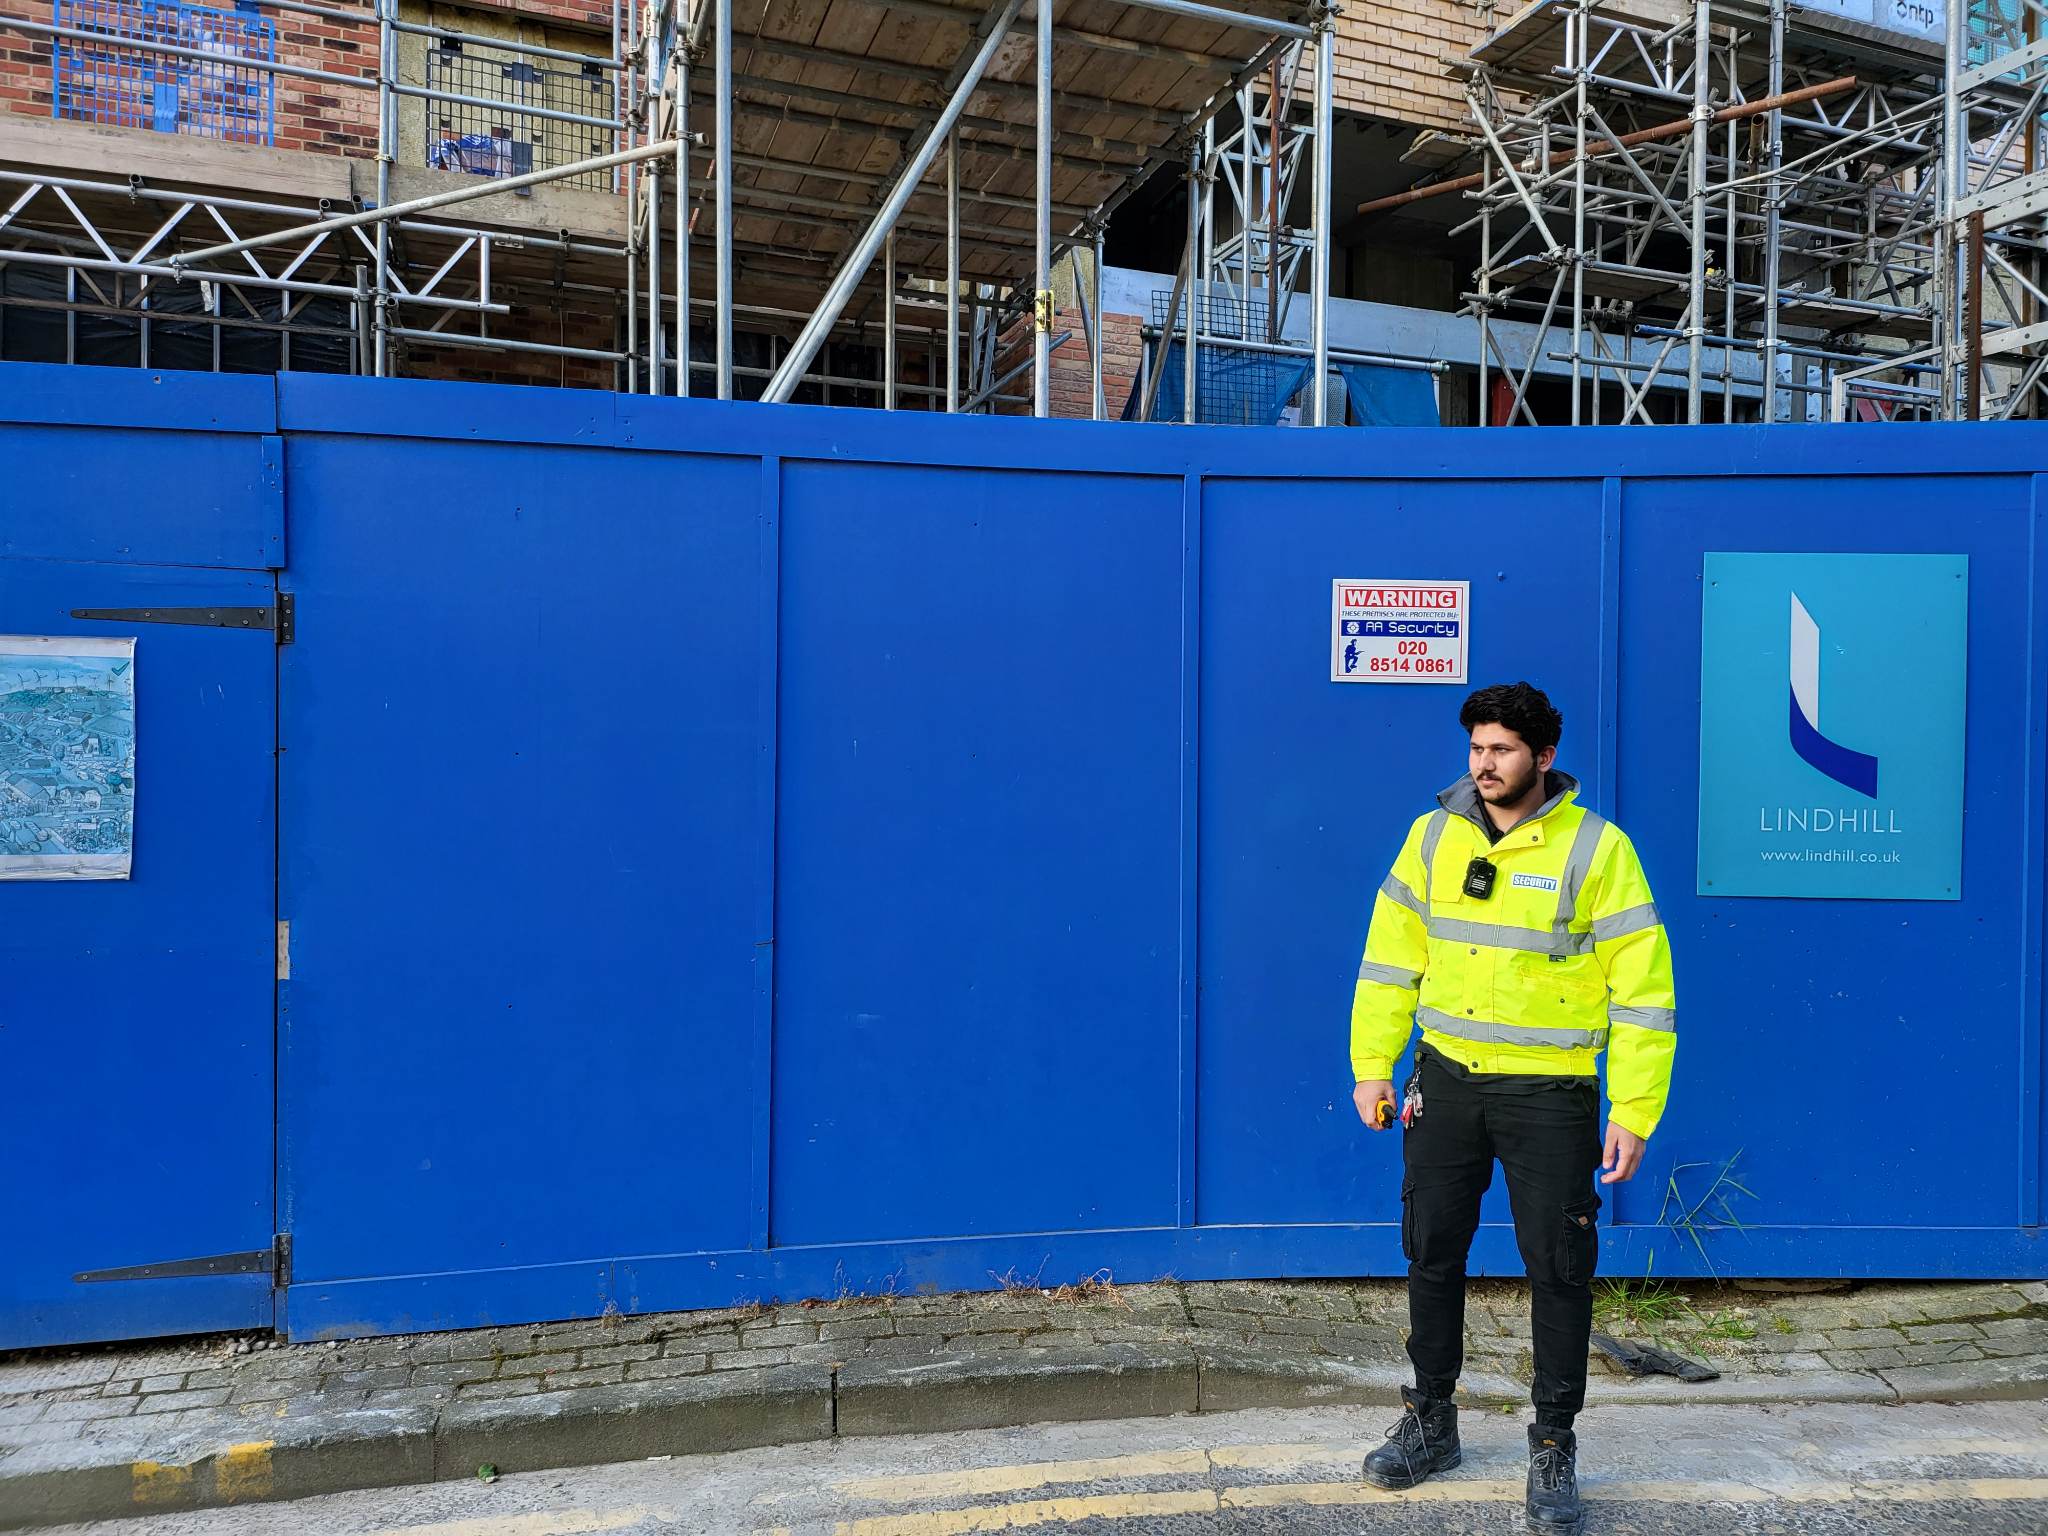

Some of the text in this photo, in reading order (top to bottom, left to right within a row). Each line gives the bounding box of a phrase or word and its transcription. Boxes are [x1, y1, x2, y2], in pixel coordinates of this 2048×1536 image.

[1346, 590, 1454, 607] WARNING
[1362, 610, 1395, 618] PREMISES
[1410, 611, 1446, 619] PROTECTED
[1365, 621, 1455, 637] AA Security
[1398, 641, 1428, 656] 020
[1370, 658, 1453, 673] 8514 0861
[1760, 807, 1902, 833] LINDHILL
[1760, 848, 1901, 864] www.lindhill.co.uk
[1513, 874, 1557, 890] SECURITY
